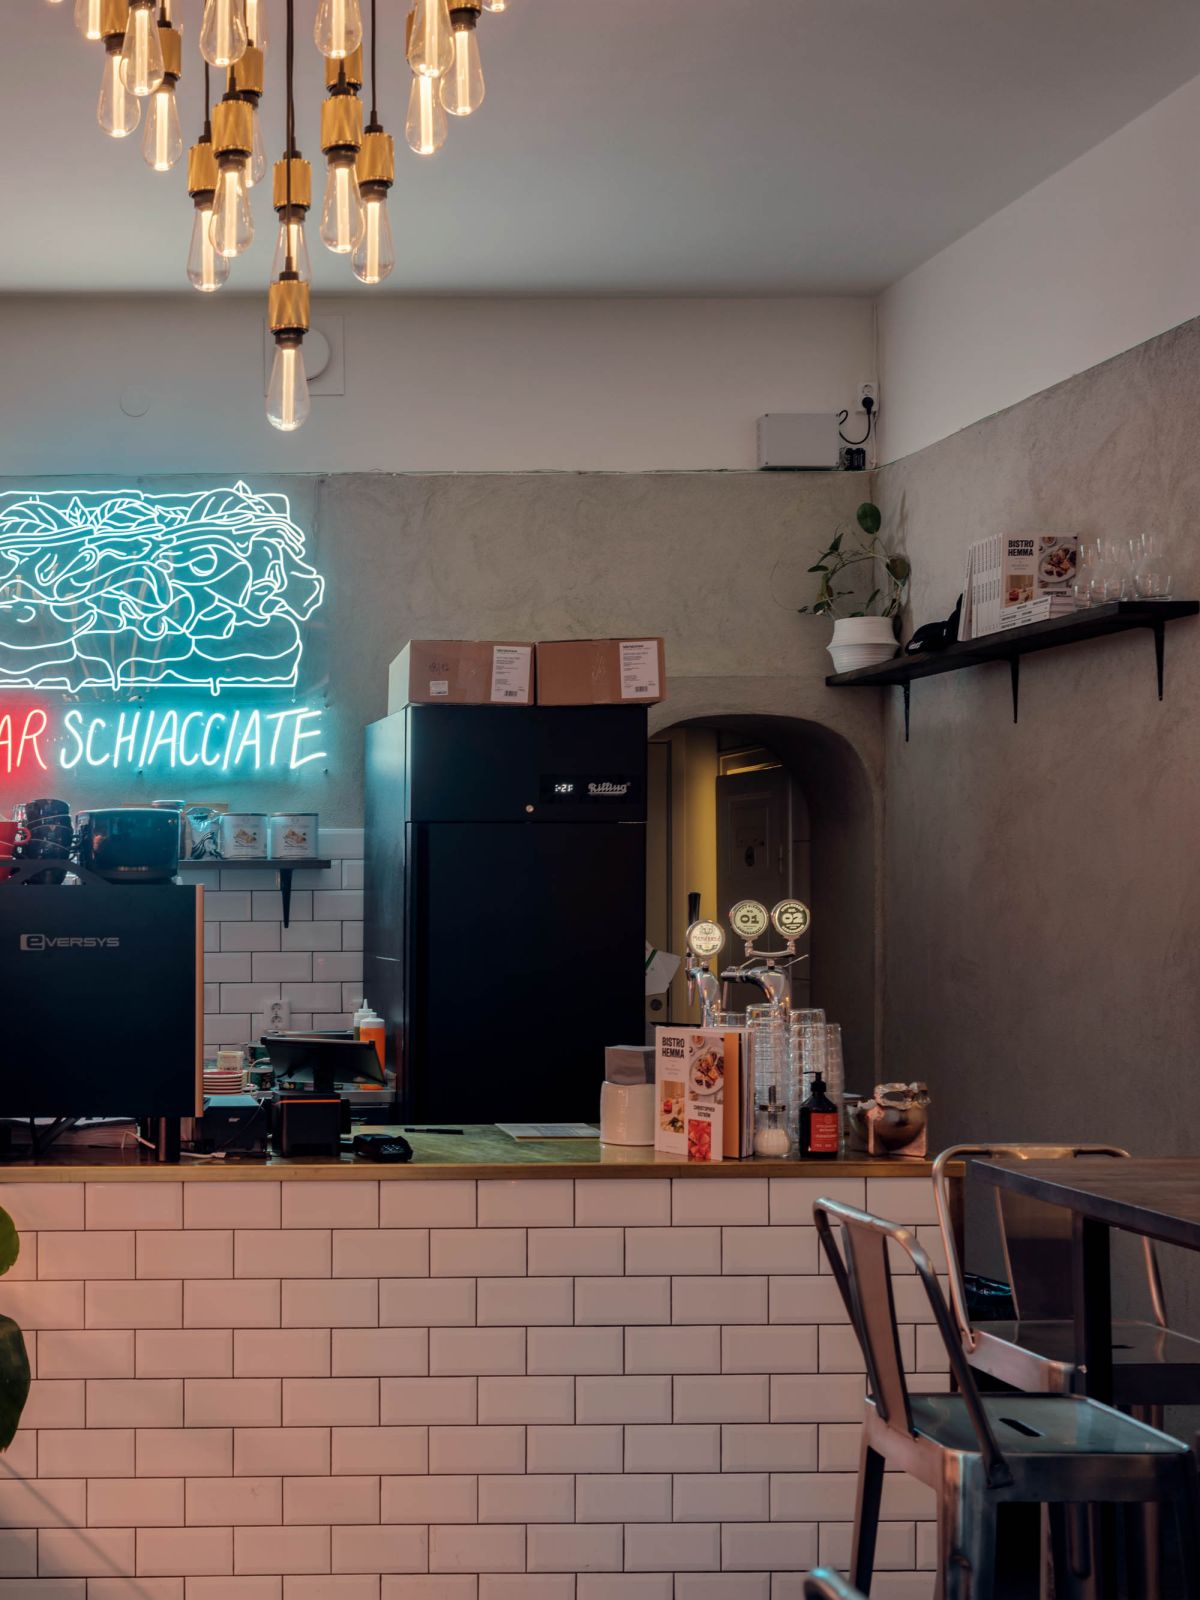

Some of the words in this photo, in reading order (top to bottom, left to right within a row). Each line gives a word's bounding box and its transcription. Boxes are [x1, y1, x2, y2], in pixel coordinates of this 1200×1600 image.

[1008, 539, 1034, 548] BISTRO
[1008, 548, 1034, 557] HEMMA
[59, 706, 328, 771] SCHIACCIATE
[740, 914, 760, 924] 01
[782, 912, 803, 924] 02
[661, 1036, 685, 1048] BISTRO
[661, 1046, 685, 1059] HEMMA
